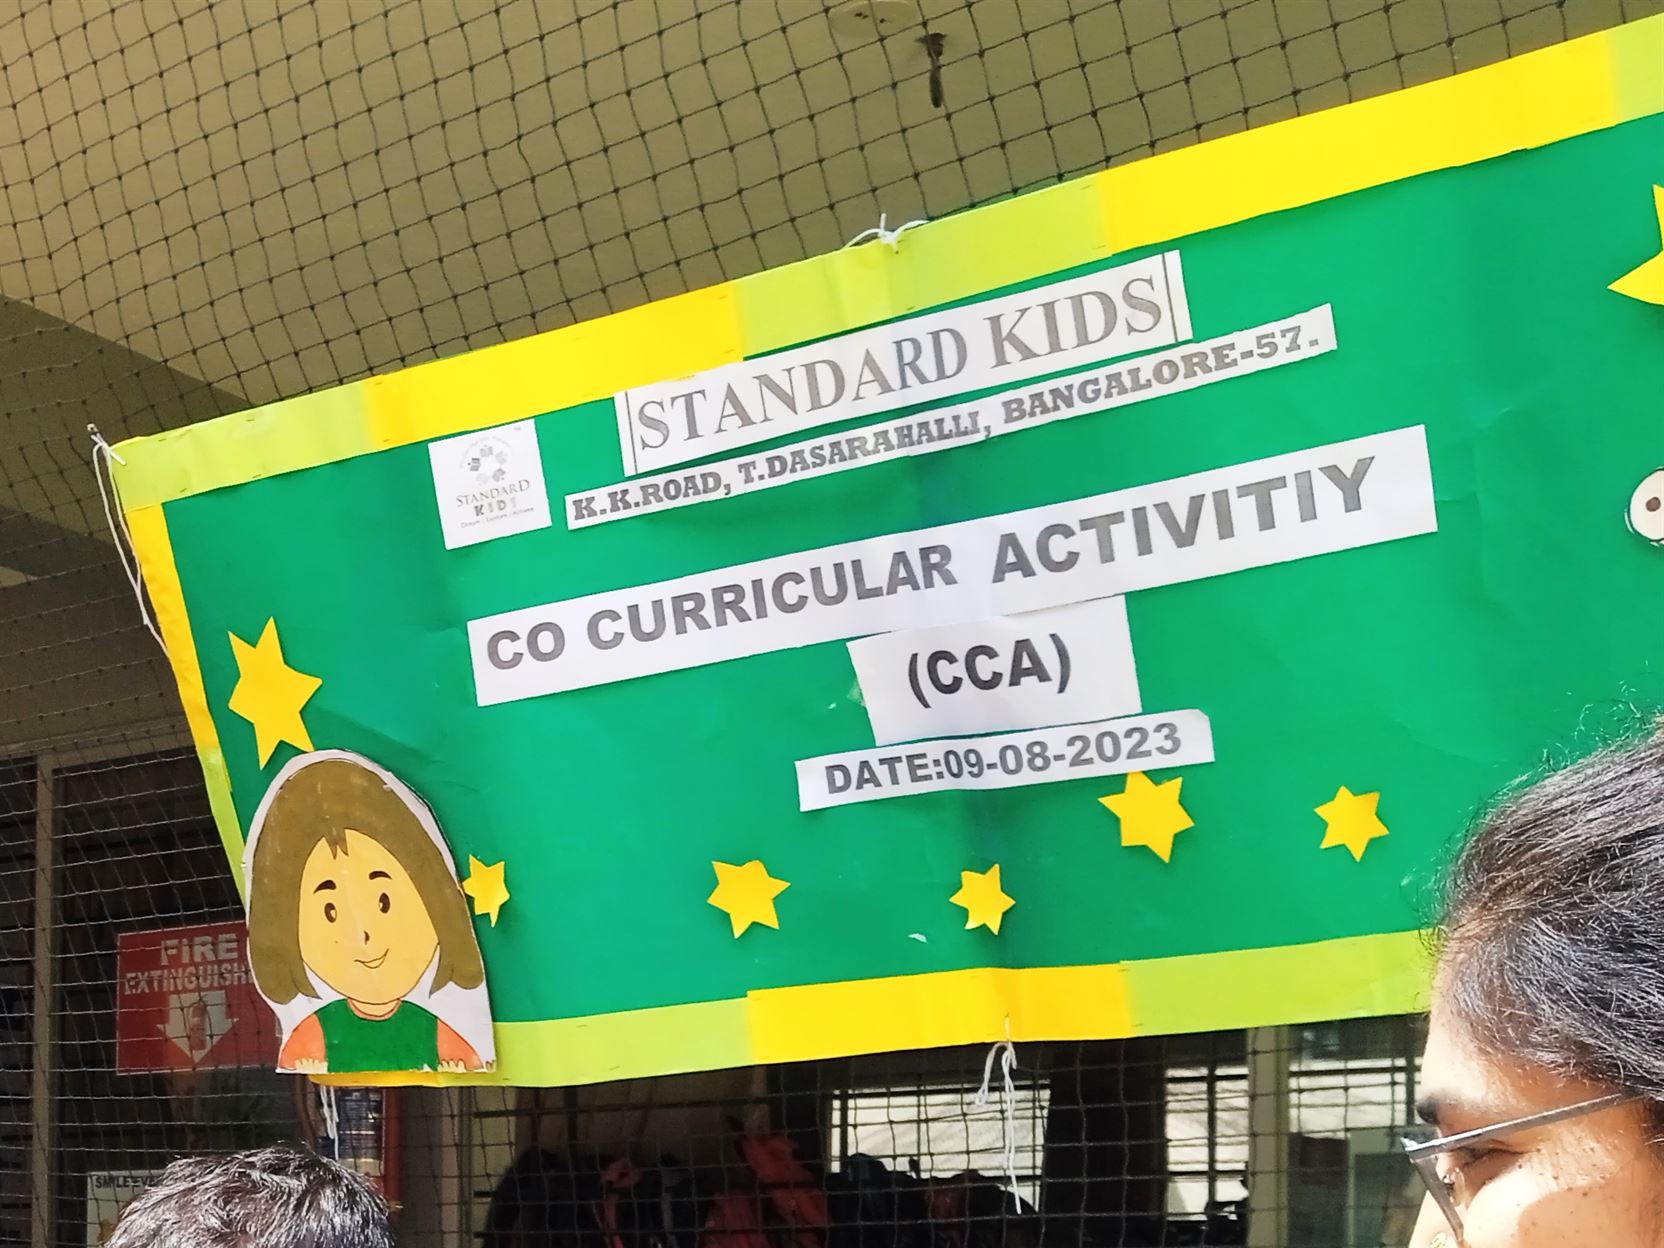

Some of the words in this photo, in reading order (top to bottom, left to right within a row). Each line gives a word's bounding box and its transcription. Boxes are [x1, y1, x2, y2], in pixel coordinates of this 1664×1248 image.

[638, 328, 968, 450] STANDARD
[984, 276, 1162, 368] KIDS
[572, 471, 732, 521] K.K.ROAD,
[738, 411, 992, 483] T.DASARAHALLI,
[1002, 326, 1319, 424] BANGALORE-57.
[455, 479, 530, 507] STANDARD
[487, 621, 566, 670] CO
[586, 545, 956, 649] CURRICULAR
[991, 455, 1376, 583] ACTIVITIY
[909, 633, 1071, 708] (CCA)
[824, 722, 1182, 795] DATE:09-08-2023
[161, 933, 238, 966] FIRE
